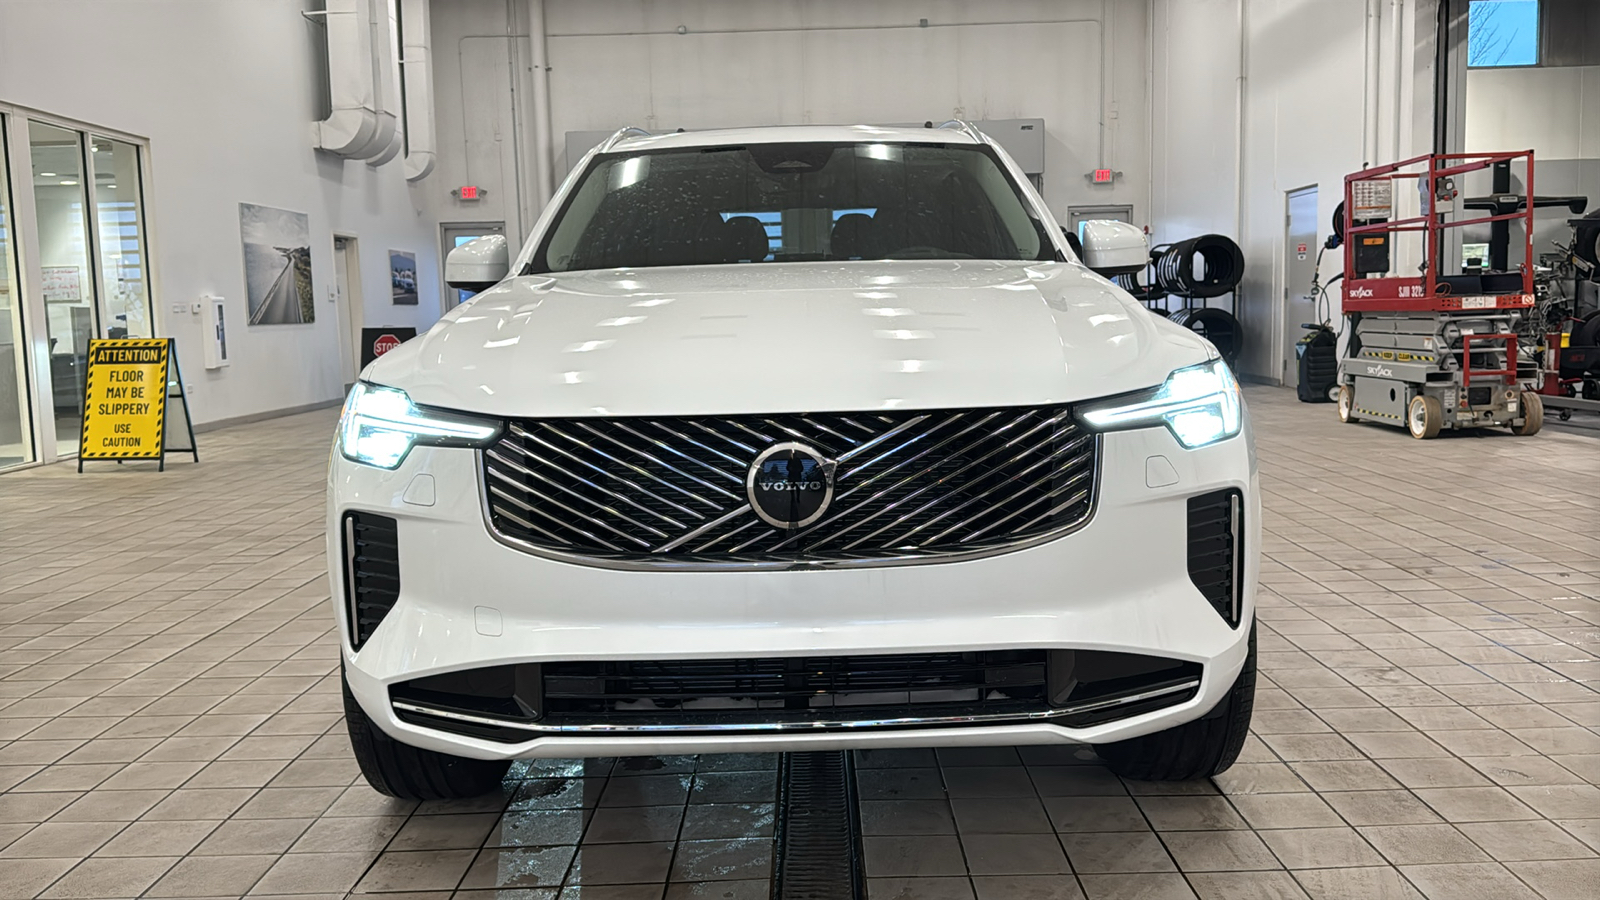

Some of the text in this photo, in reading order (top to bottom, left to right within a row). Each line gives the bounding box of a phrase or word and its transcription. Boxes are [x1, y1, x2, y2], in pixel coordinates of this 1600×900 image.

[1095, 169, 1110, 182] EXIT
[461, 186, 477, 199] EXIT
[97, 349, 159, 362] ATTENTION
[109, 370, 144, 382] FLOOR
[106, 387, 145, 398] MAY BE
[98, 403, 150, 415] SLIPPERY
[114, 423, 132, 434] USE
[102, 437, 141, 447] CAUTION
[759, 481, 821, 491] VOLVO
